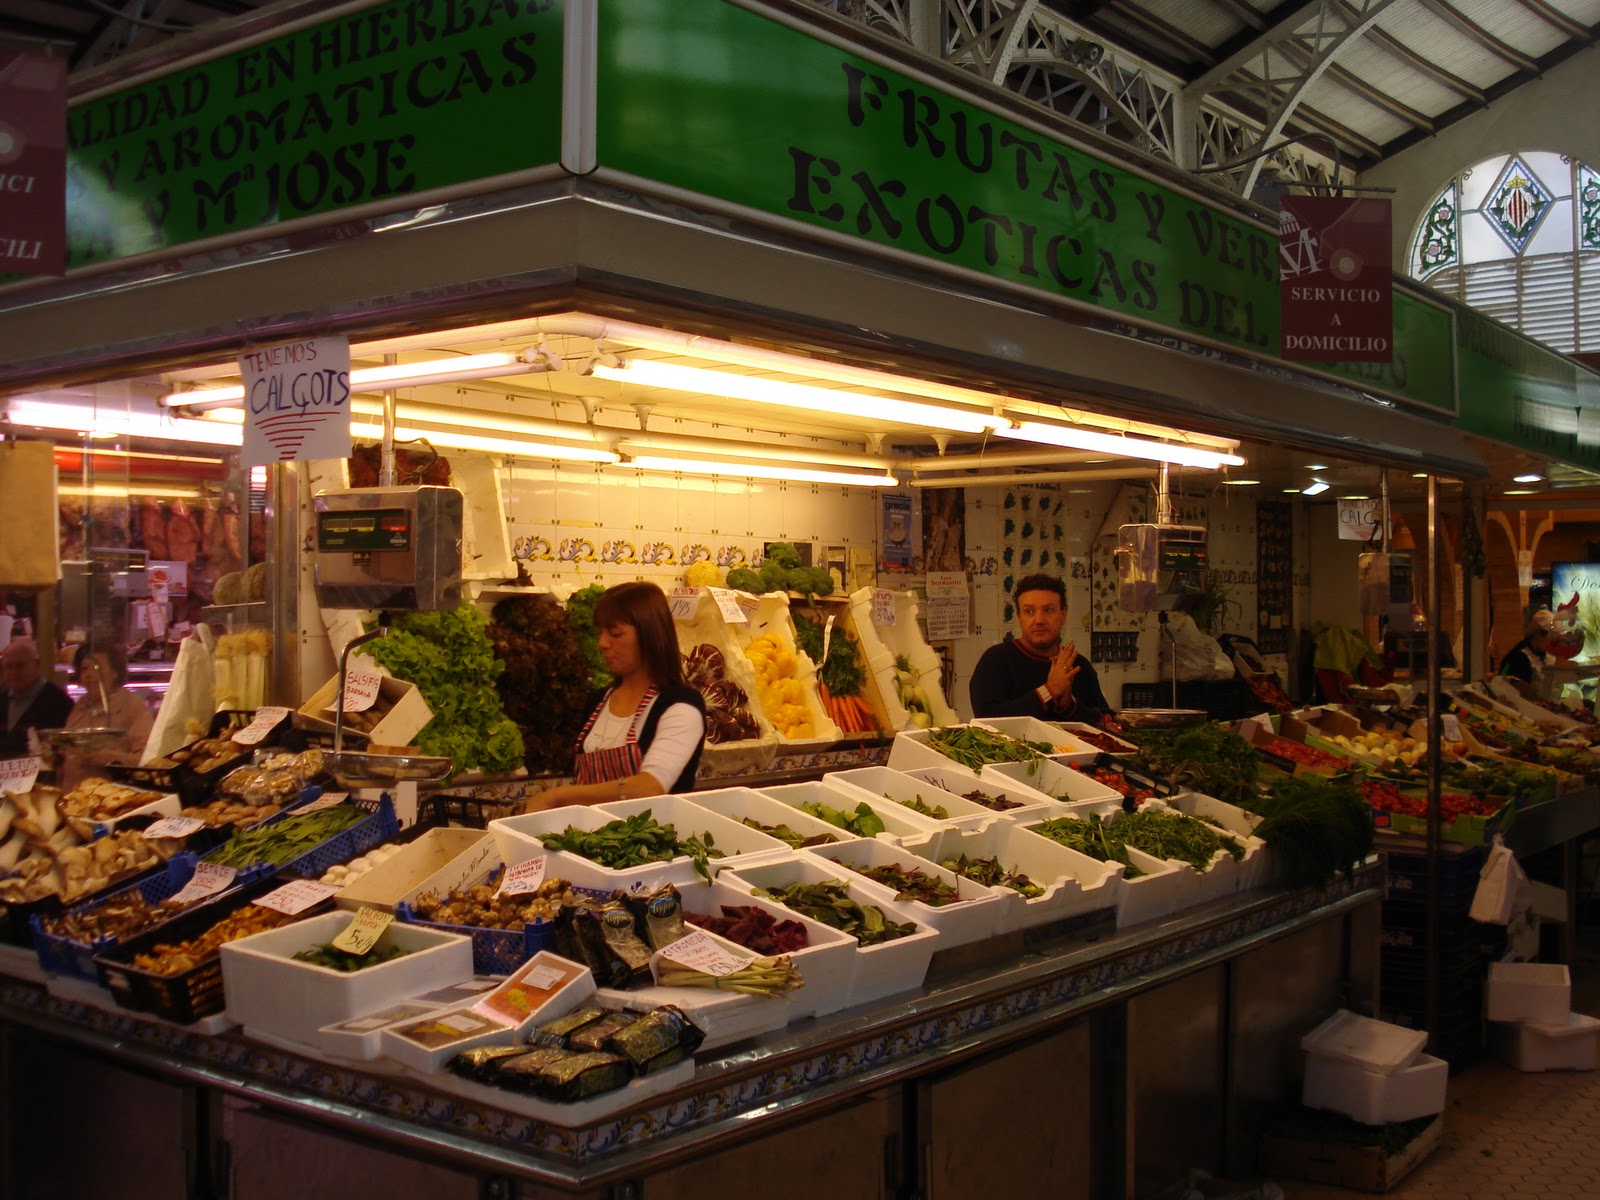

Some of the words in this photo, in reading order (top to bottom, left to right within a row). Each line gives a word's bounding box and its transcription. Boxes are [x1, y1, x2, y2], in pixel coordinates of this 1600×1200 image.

[67, 70, 209, 149] ALIDAD
[234, 38, 297, 97] EN
[309, 0, 554, 75] HIERBA
[134, 32, 537, 182] AROMATICAS
[261, 134, 416, 223] JOSE
[842, 61, 1118, 224] FRUTAS
[1136, 190, 1166, 246] Y
[1186, 207, 1281, 283] VER
[786, 146, 1160, 313] EXOTICAS
[1179, 279, 1269, 347] DEL
[1291, 286, 1381, 303] SERVICIO
[1285, 334, 1388, 352] DOMICILIO
[1330, 313, 1342, 327] A
[243, 341, 317, 373] TENEMOS
[250, 368, 350, 417] CALÇOTS
[1340, 500, 1379, 509] TENEMO
